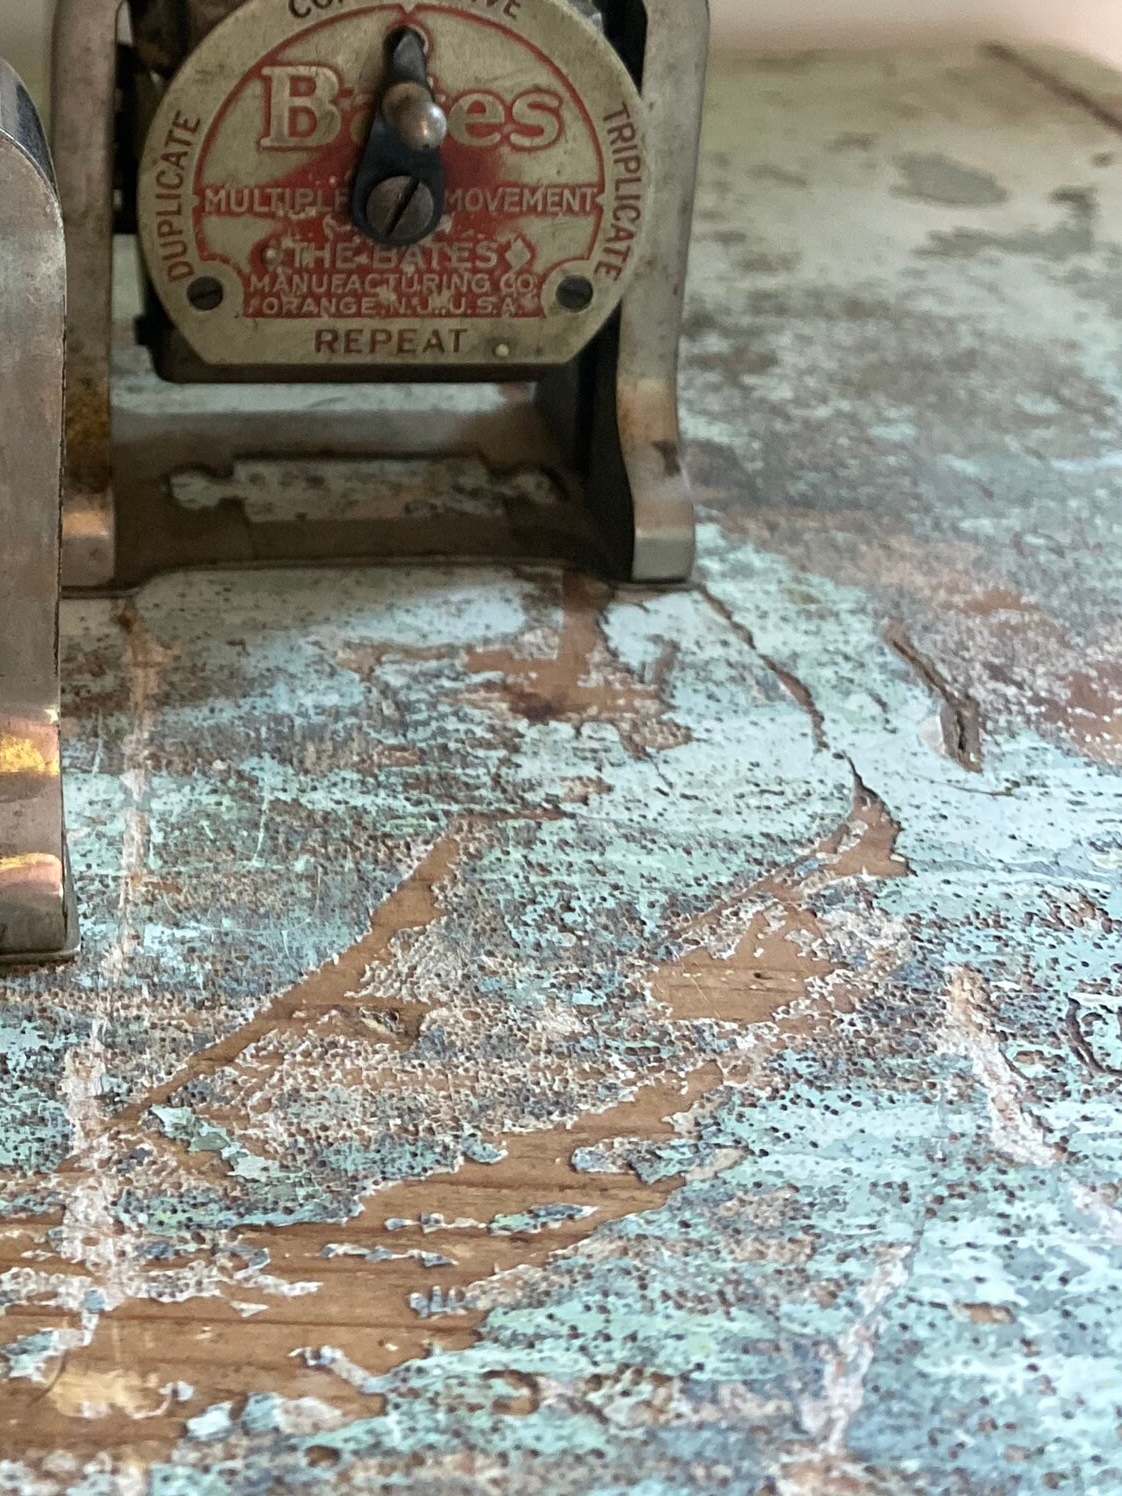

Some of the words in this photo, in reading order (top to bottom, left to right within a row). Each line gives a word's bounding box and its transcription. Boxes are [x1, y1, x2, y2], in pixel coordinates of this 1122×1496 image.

[259, 64, 565, 152] Bes
[154, 110, 201, 283] DUPLICATE
[446, 187, 597, 213] MOVEMENT
[594, 102, 643, 282] TRIPLICATE
[288, 242, 358, 270] THE
[373, 241, 499, 269] BATES
[249, 273, 490, 293] MANUFACTURING
[314, 328, 468, 355] REPEAT
